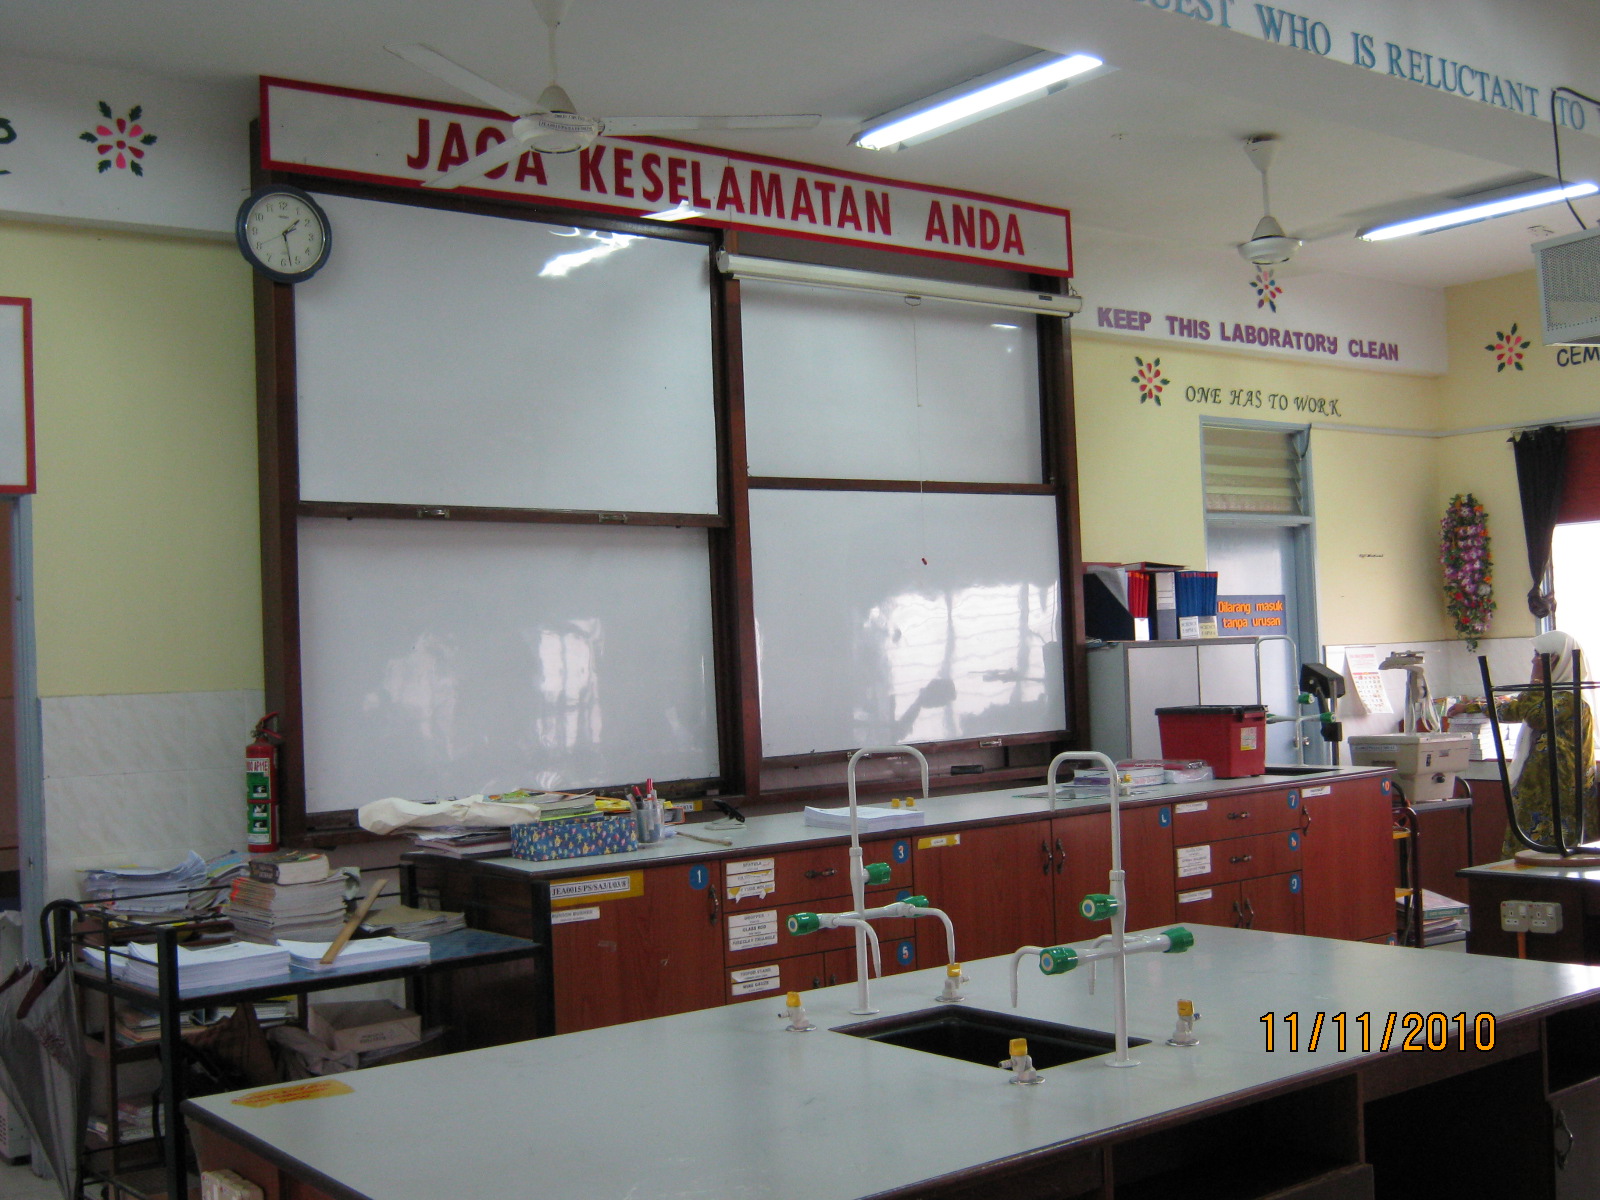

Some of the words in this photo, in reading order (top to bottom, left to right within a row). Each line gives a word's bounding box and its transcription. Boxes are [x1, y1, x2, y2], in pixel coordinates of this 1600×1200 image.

[1254, 3, 1332, 55] WHO
[1351, 32, 1376, 69] IS
[1385, 42, 1539, 117] RELUCTANT
[1555, 95, 1586, 131] TO
[579, 145, 892, 236] KESELAMATAN
[925, 200, 1025, 256] ANDA
[1097, 306, 1152, 331] KEEP
[1165, 315, 1211, 340] THIS
[1219, 321, 1338, 355] LABORATORY
[1348, 339, 1399, 361] CLEAN
[1556, 346, 1600, 367] CEM
[1185, 385, 1222, 404] ONE
[1229, 389, 1262, 409] HAS
[1268, 393, 1288, 411] TO
[1293, 395, 1342, 417] WORK
[1218, 601, 1251, 614] Dilarang
[1255, 600, 1283, 612] masuk
[1222, 618, 1248, 630] tanpa
[1252, 617, 1281, 627] urusan
[897, 845, 904, 859] 3
[697, 869, 702, 884] 1
[902, 946, 909, 959] 5
